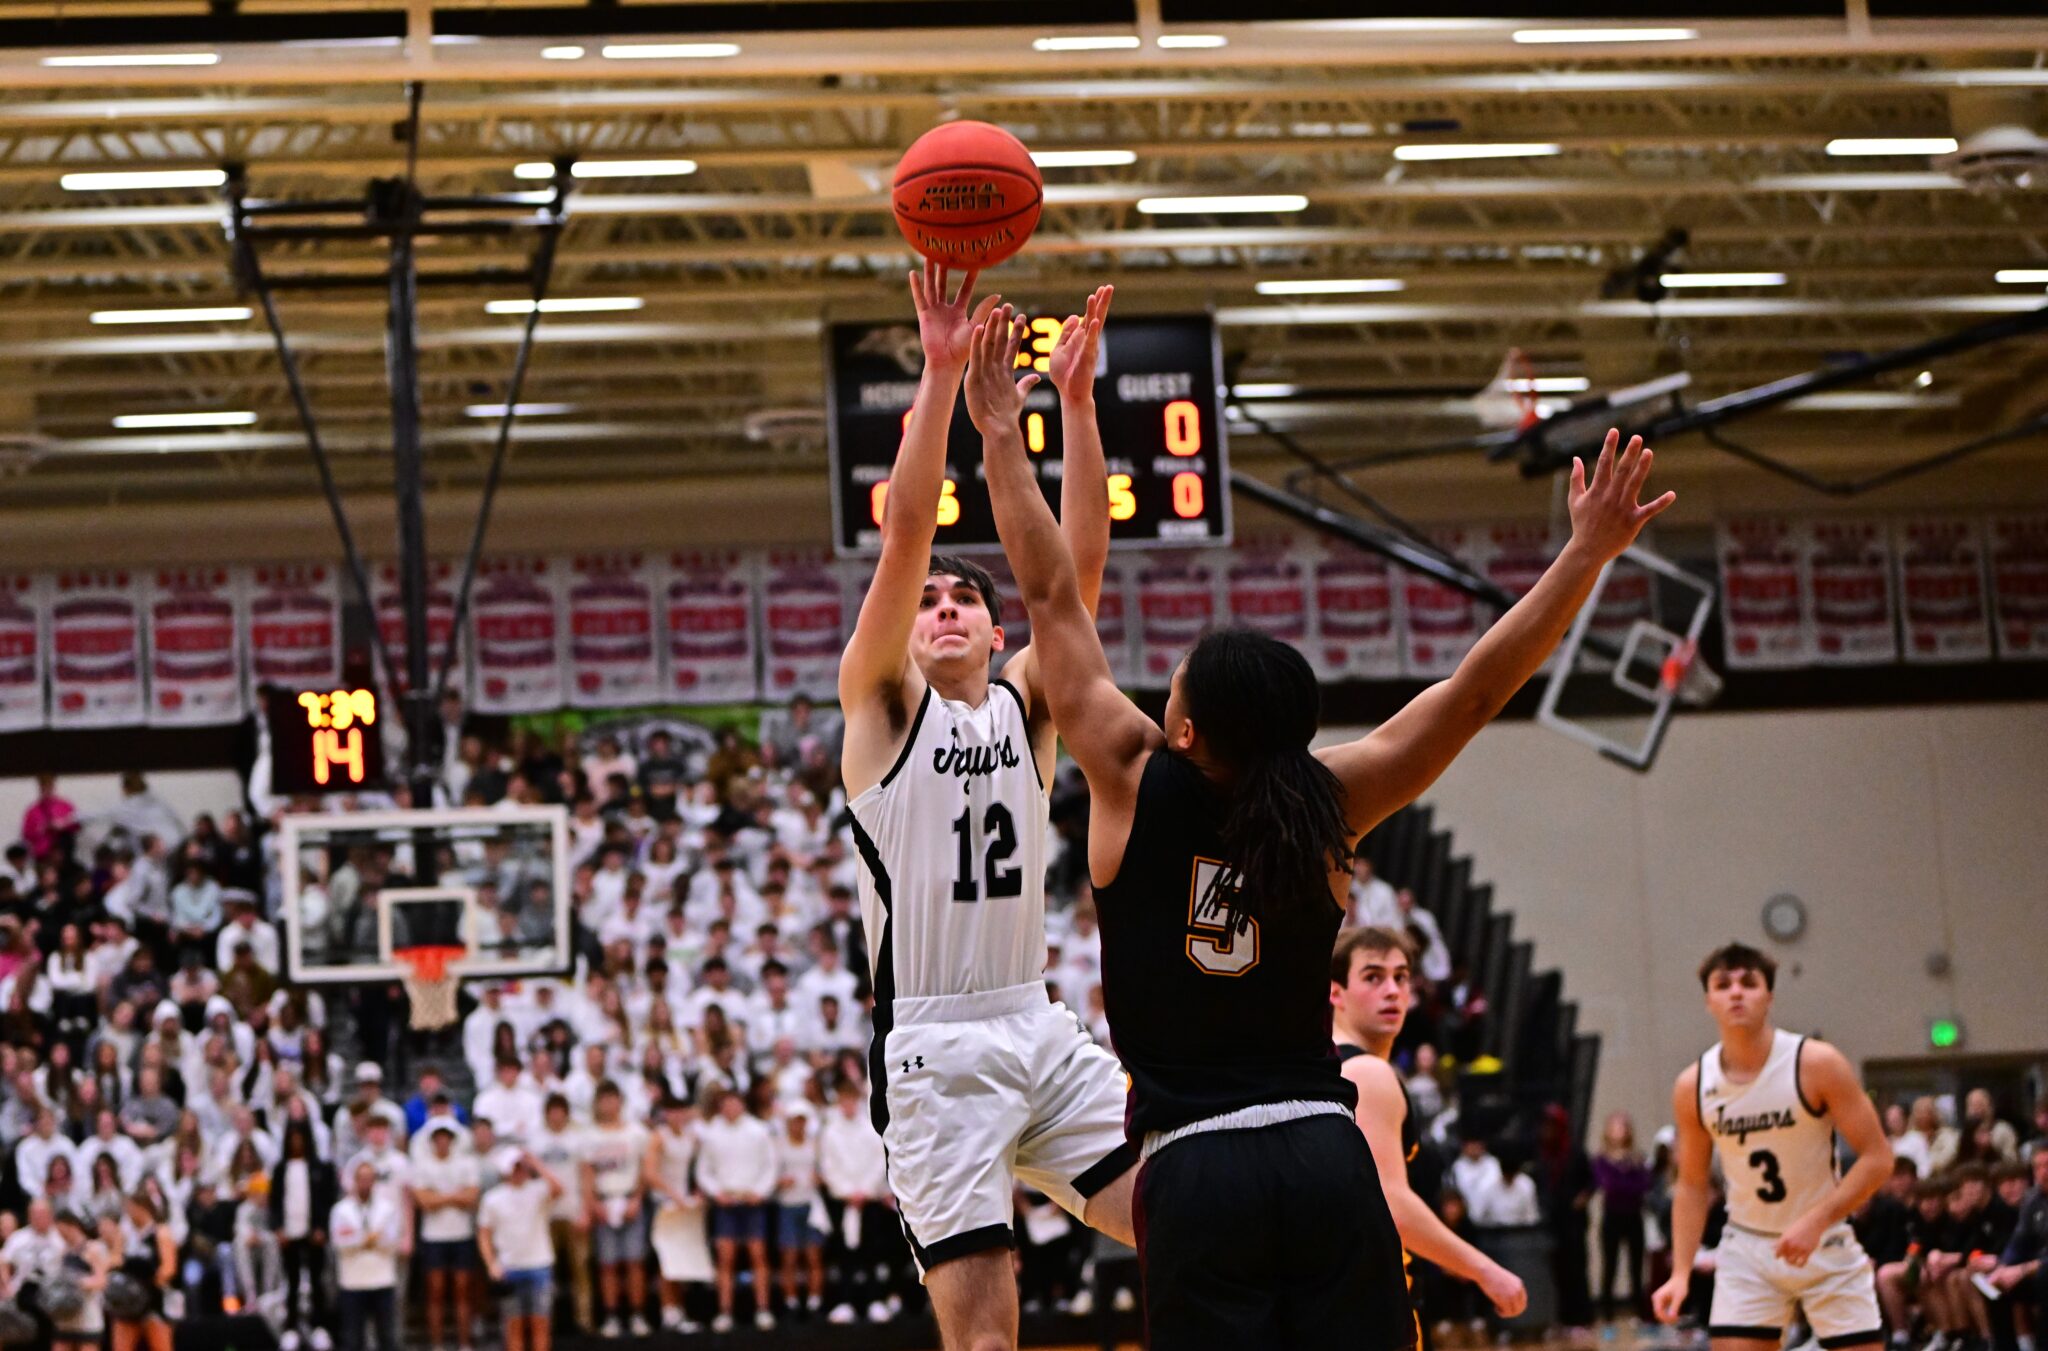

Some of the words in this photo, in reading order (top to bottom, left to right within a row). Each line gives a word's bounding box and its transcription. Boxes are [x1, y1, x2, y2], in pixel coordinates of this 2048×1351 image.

[1117, 373, 1192, 401] GUEST
[1164, 401, 1201, 456] 0
[1108, 474, 1136, 520] 5
[1172, 472, 1204, 518] 0
[313, 727, 364, 784] 14
[952, 802, 1022, 902] 12
[1186, 856, 1260, 977] 5
[1712, 1104, 1797, 1146] Jaguars
[1749, 1148, 1787, 1203] 3
